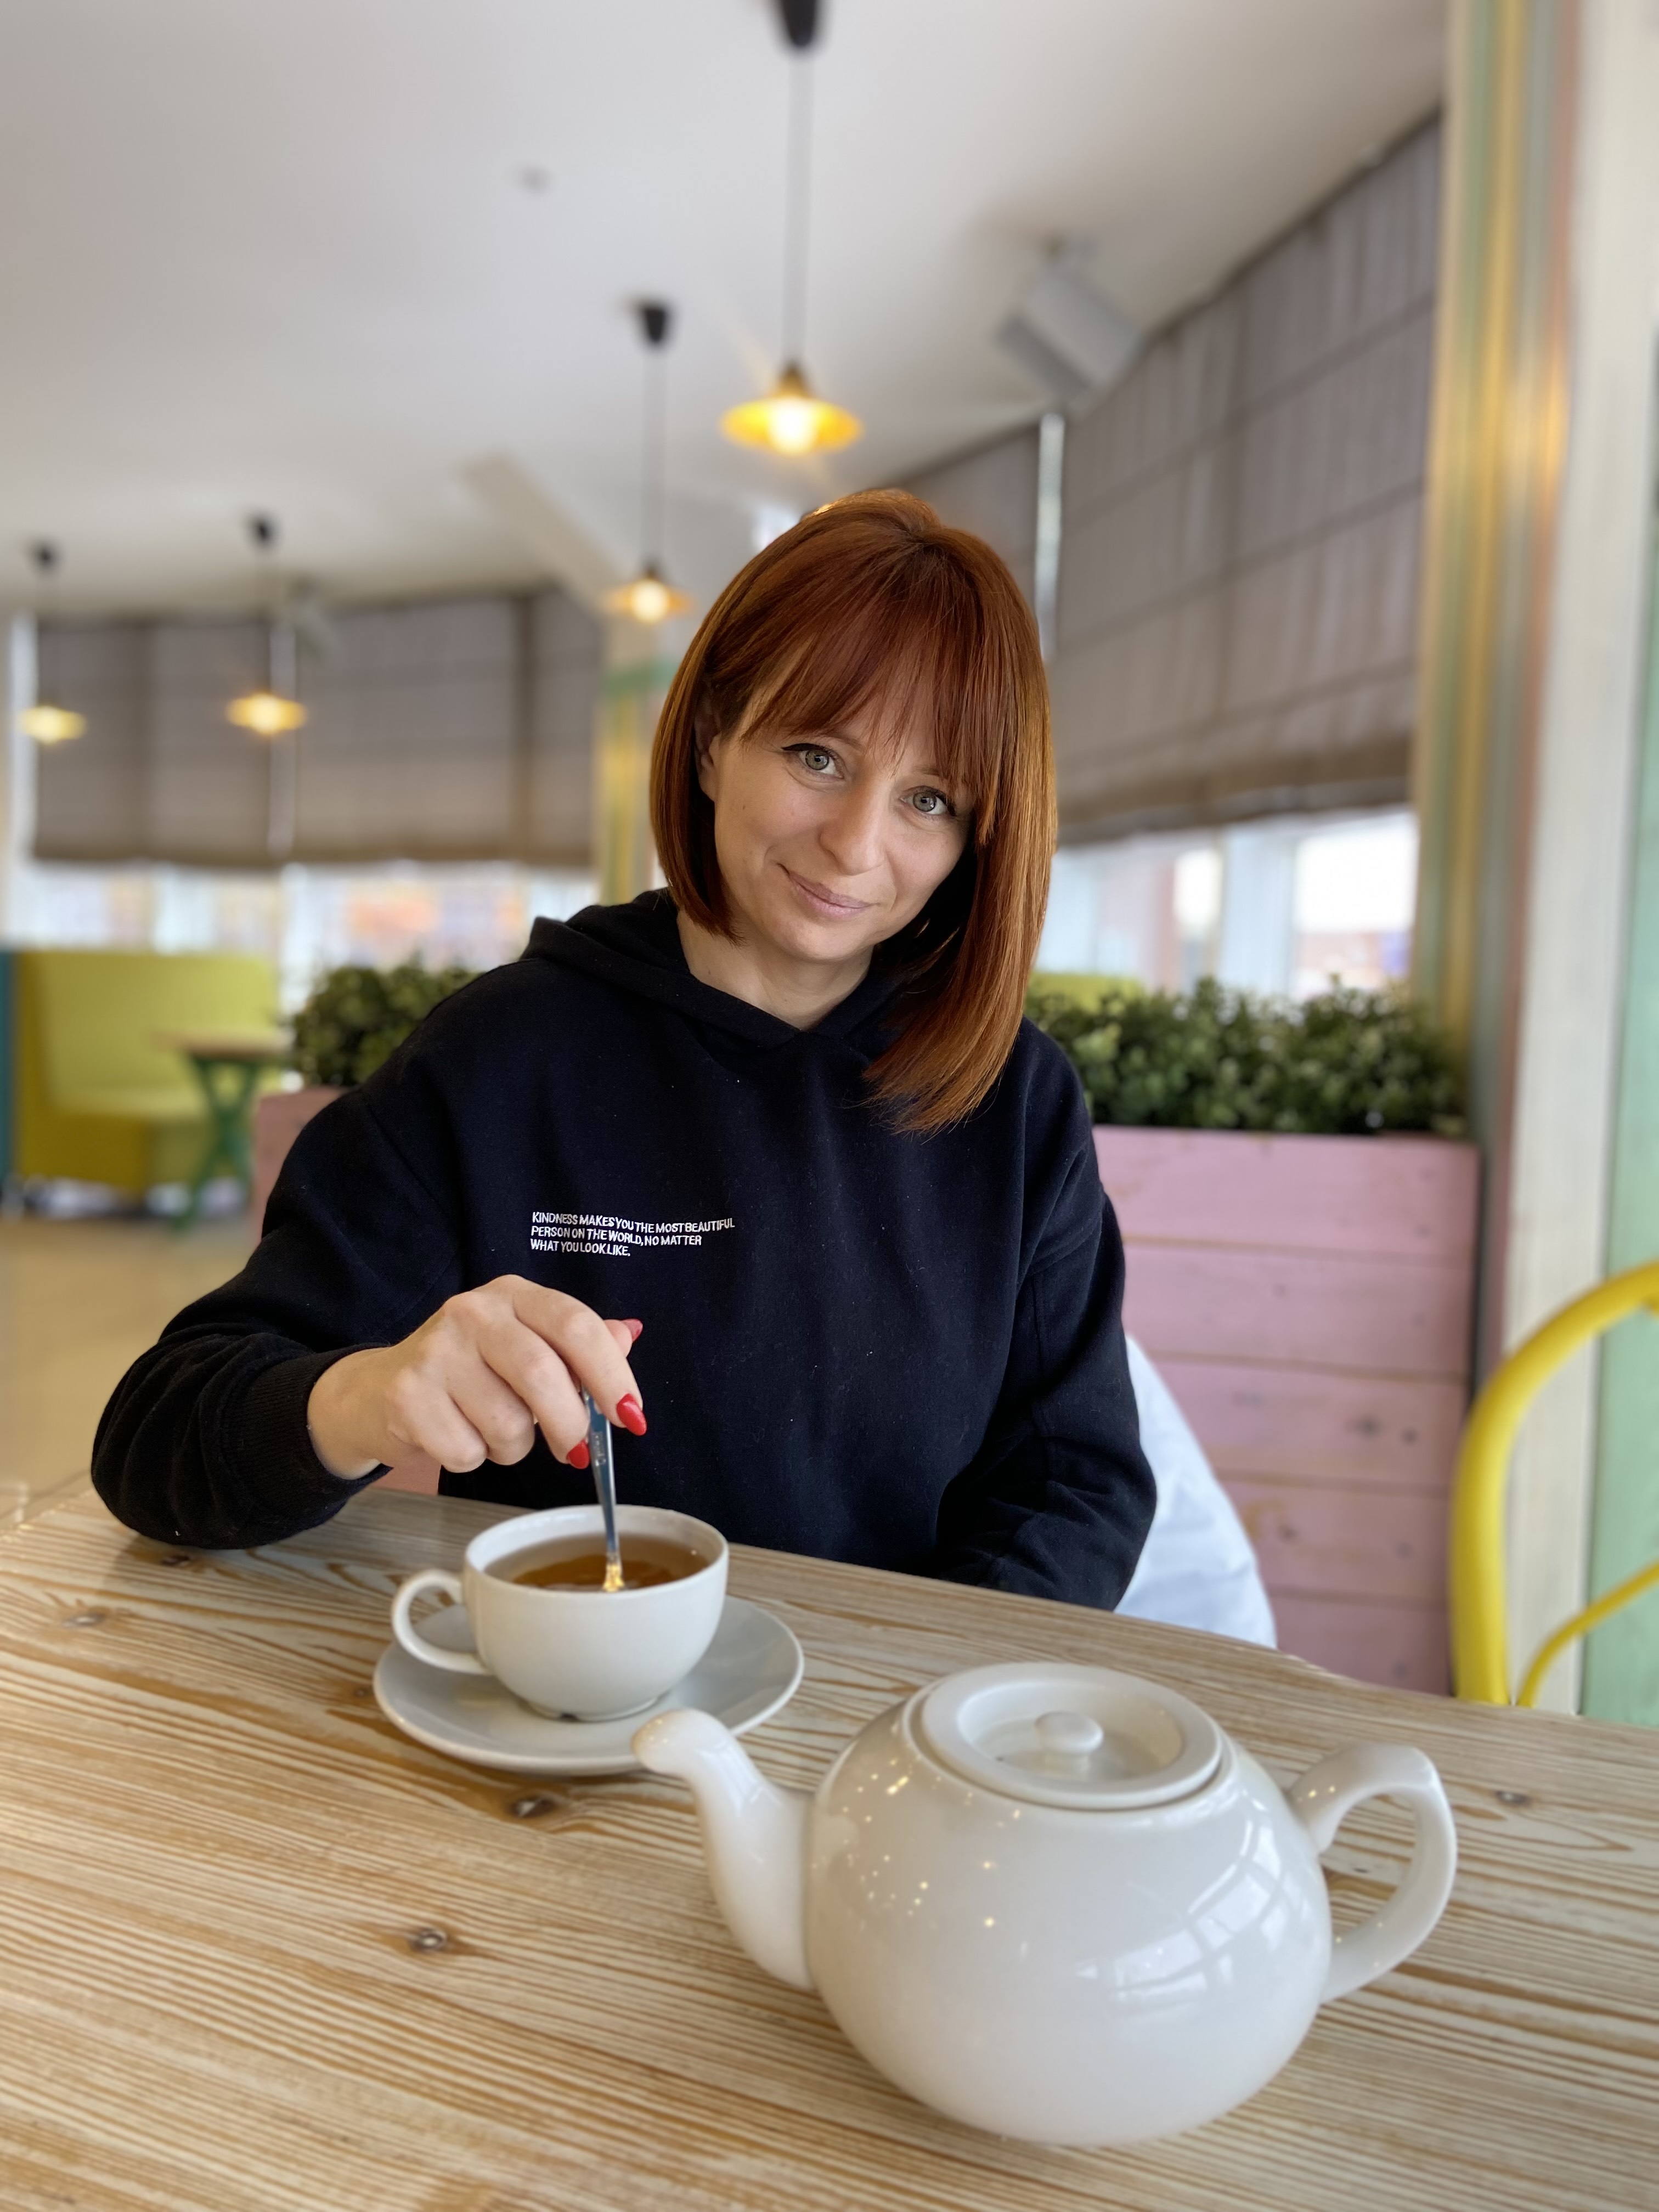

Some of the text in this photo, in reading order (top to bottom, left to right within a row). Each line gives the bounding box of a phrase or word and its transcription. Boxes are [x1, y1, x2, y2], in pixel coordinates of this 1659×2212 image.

[532, 1212, 735, 1233] KINDNESS MAKES YOU THE MOST BEAUTIFUL
[531, 1226, 702, 1246] PERSON ON THE WORLD, NO MATTER
[530, 1239, 559, 1251] WHAT
[561, 1242, 579, 1252] YOU
[580, 1243, 606, 1254] LOOK
